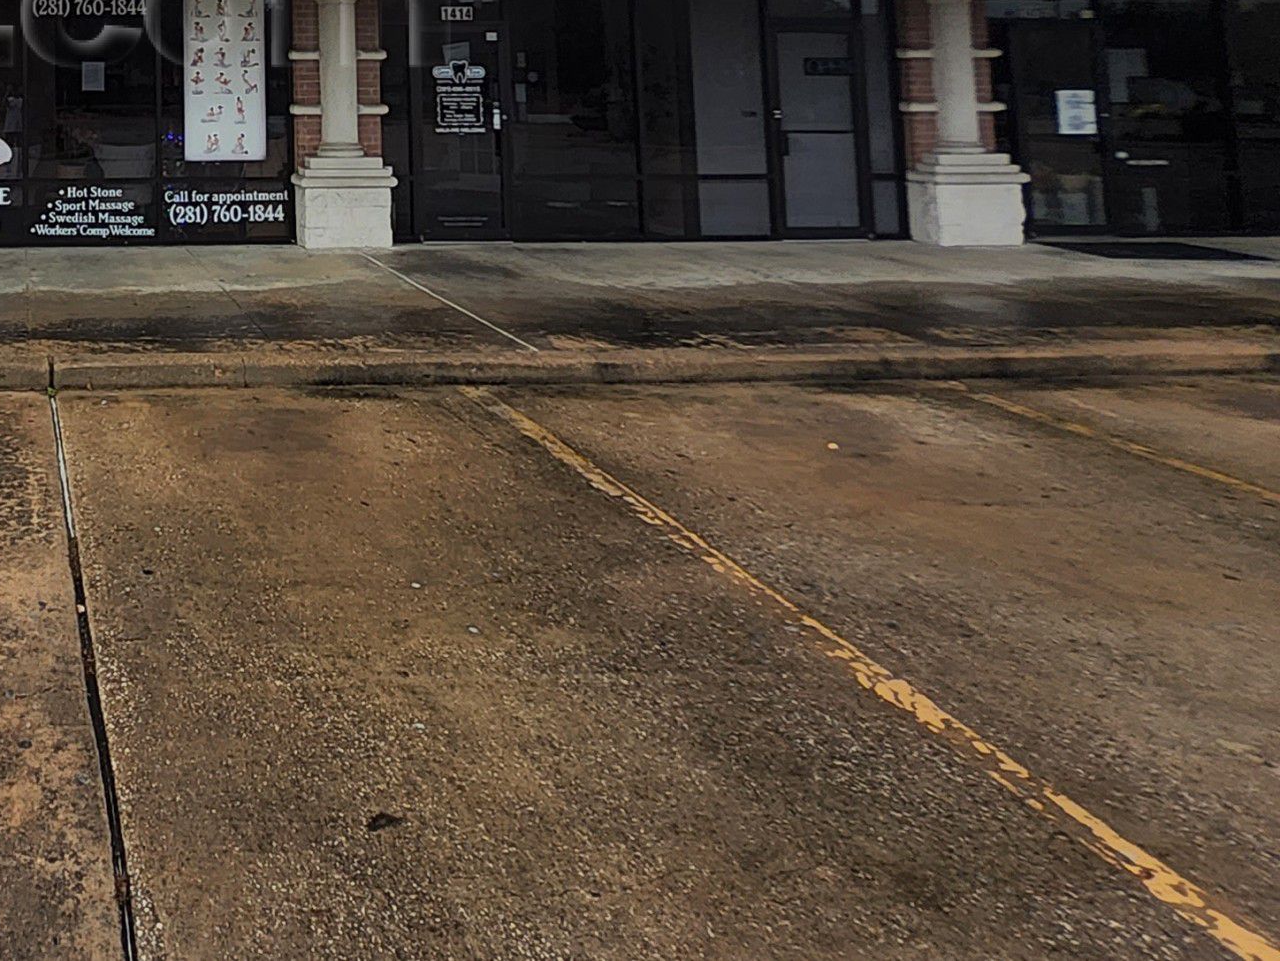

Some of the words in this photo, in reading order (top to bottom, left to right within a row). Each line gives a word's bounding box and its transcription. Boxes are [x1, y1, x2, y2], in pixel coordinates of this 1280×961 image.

[441, 7, 473, 21] 1414
[67, 188, 87, 197] Hot
[90, 188, 123, 198] Stone
[164, 191, 189, 202] Call
[191, 191, 208, 202] for
[211, 190, 289, 205] appointment
[55, 200, 86, 211] Sport
[88, 200, 134, 212] Massage
[48, 212, 95, 223] Swedish
[98, 213, 144, 225] Massage
[169, 206, 208, 225] (281)
[212, 205, 285, 224] 760-1844
[80, 226, 110, 238] Comp
[110, 226, 155, 236] Welcome
